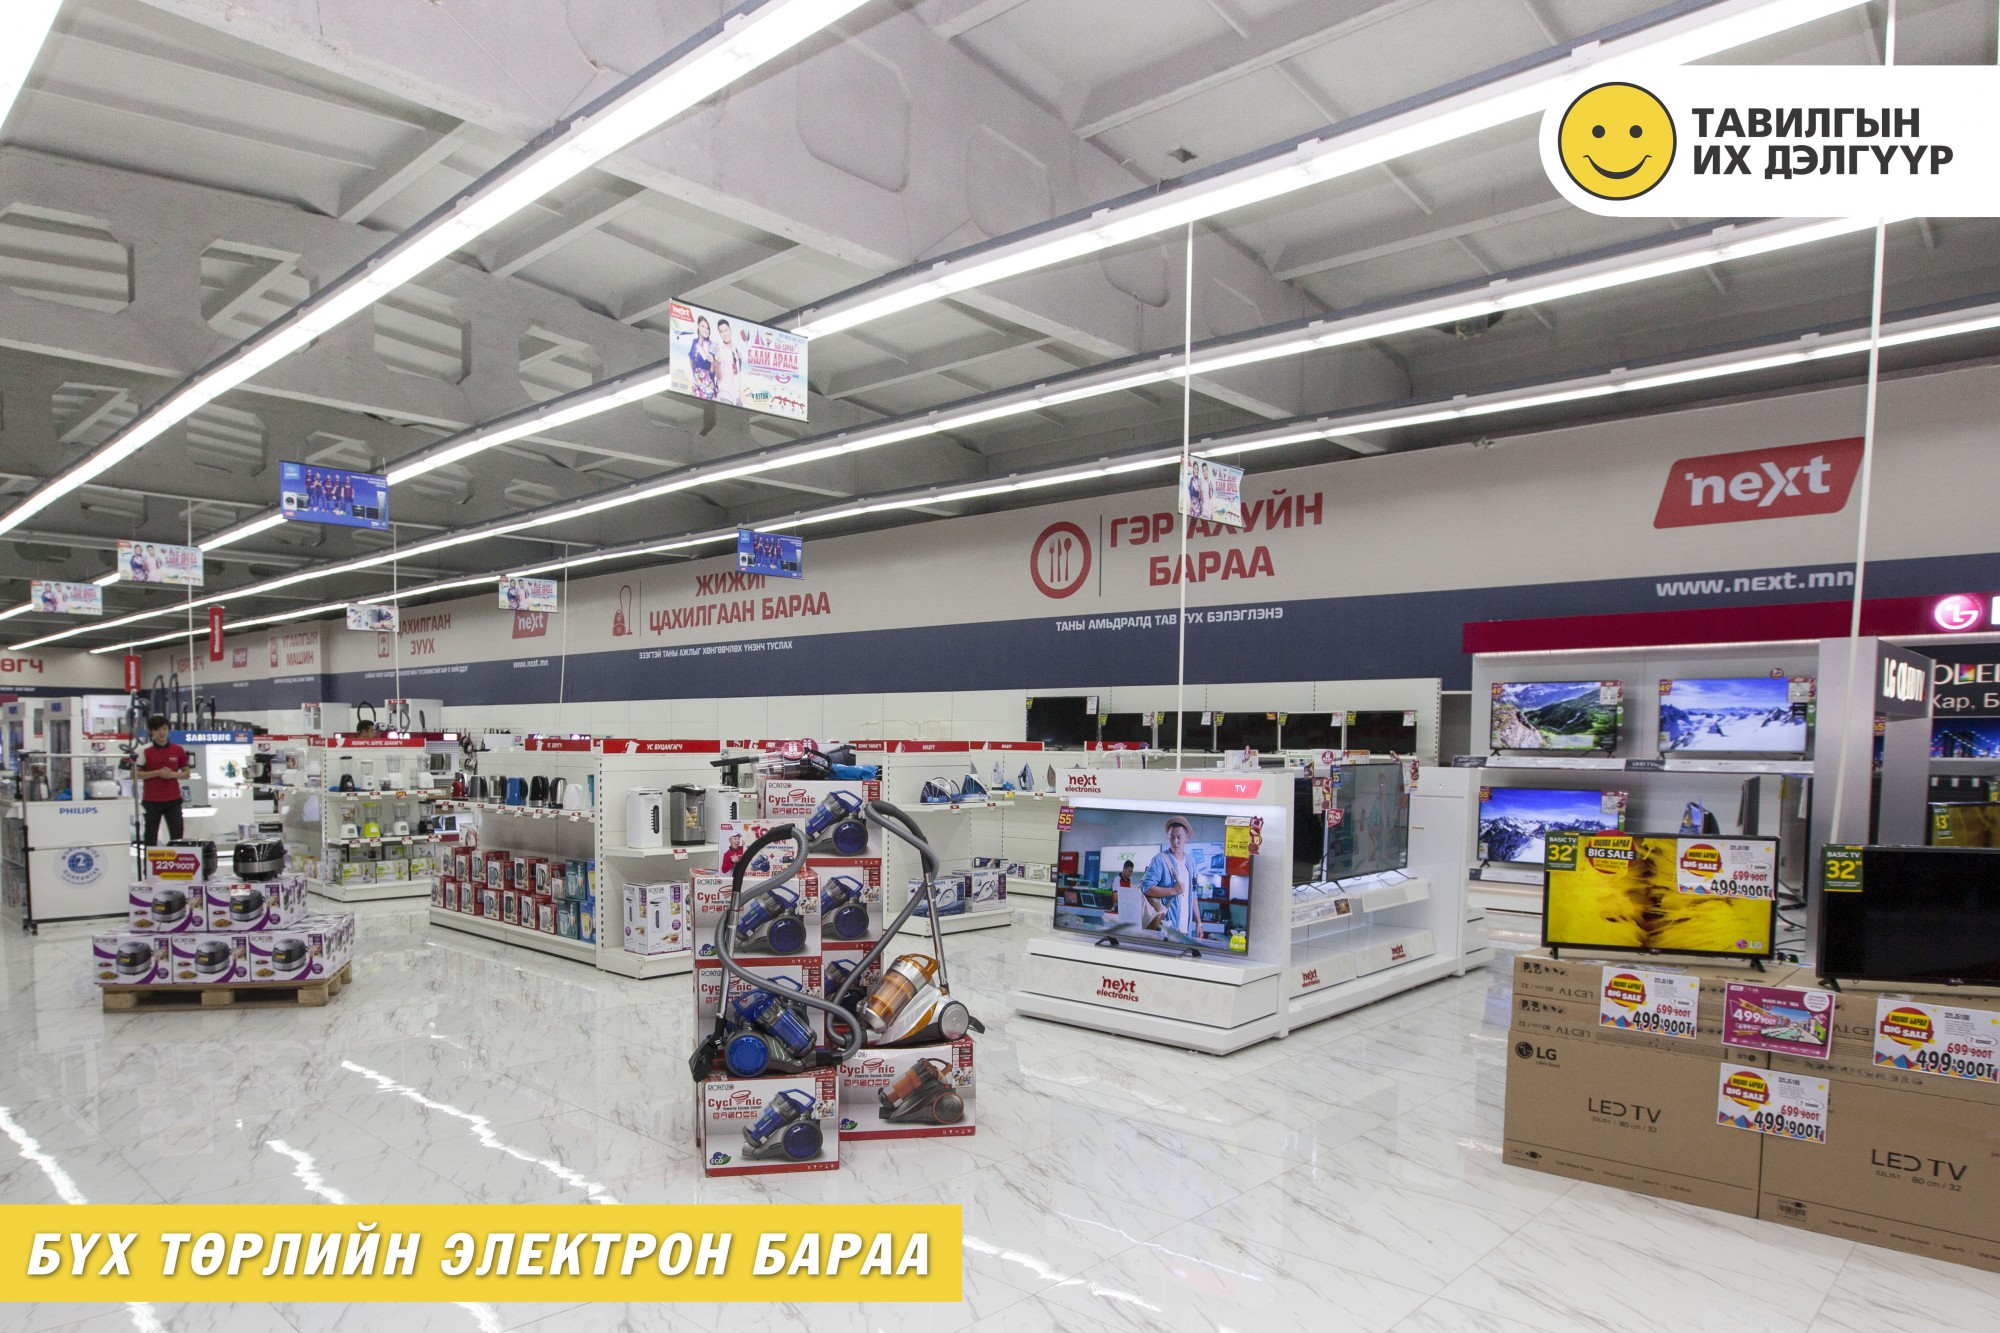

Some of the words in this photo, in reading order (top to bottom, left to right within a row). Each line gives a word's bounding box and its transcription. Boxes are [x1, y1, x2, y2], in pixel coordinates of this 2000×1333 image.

[1685, 455, 1831, 507] next
[1110, 512, 1174, 547] ГЭР
[1150, 546, 1274, 586] БАРАА
[1656, 569, 1854, 597] www.next.mn
[650, 600, 754, 635] ЦАХИЛГААН
[762, 591, 831, 620] БАРАА
[1056, 620, 1085, 631] ТАНЫ
[1088, 616, 1151, 629] АМЬДРАЛД
[1155, 614, 1176, 625] ТАВ
[1207, 607, 1283, 623] БЭЛЭГЛЭНЭ
[517, 613, 544, 631] next
[411, 639, 434, 655] ЗУУХ
[662, 649, 678, 658] ТАНЫ
[766, 640, 792, 651] ТУСЛАХ
[1934, 664, 2000, 685] OLE
[1068, 774, 1097, 786] next
[1065, 785, 1101, 793] electronics
[76, 854, 87, 867] 2
[1588, 848, 1605, 857] BIG
[1607, 849, 1633, 859] SALE
[1391, 943, 1404, 955] next
[1749, 940, 1762, 949] LG
[1302, 969, 1317, 981] next
[1102, 976, 1136, 993] next
[1096, 988, 1138, 1002] electronics
[1608, 989, 1621, 997] BIG
[1622, 993, 1641, 1001] SALE
[1884, 1025, 1900, 1034] BIG
[1902, 1029, 1928, 1039] SALE
[1536, 1046, 1557, 1060] LG
[1726, 1087, 1741, 1095] BIG
[1742, 1091, 1764, 1101] SALE
[1588, 1098, 1626, 1117] LED
[1631, 1104, 1661, 1123] TV
[1619, 1121, 1629, 1129] 80
[1871, 1149, 1921, 1171] LED
[1927, 1158, 1967, 1181] TV
[1911, 1176, 1924, 1185] 80
[1947, 1184, 1961, 1192] 32
